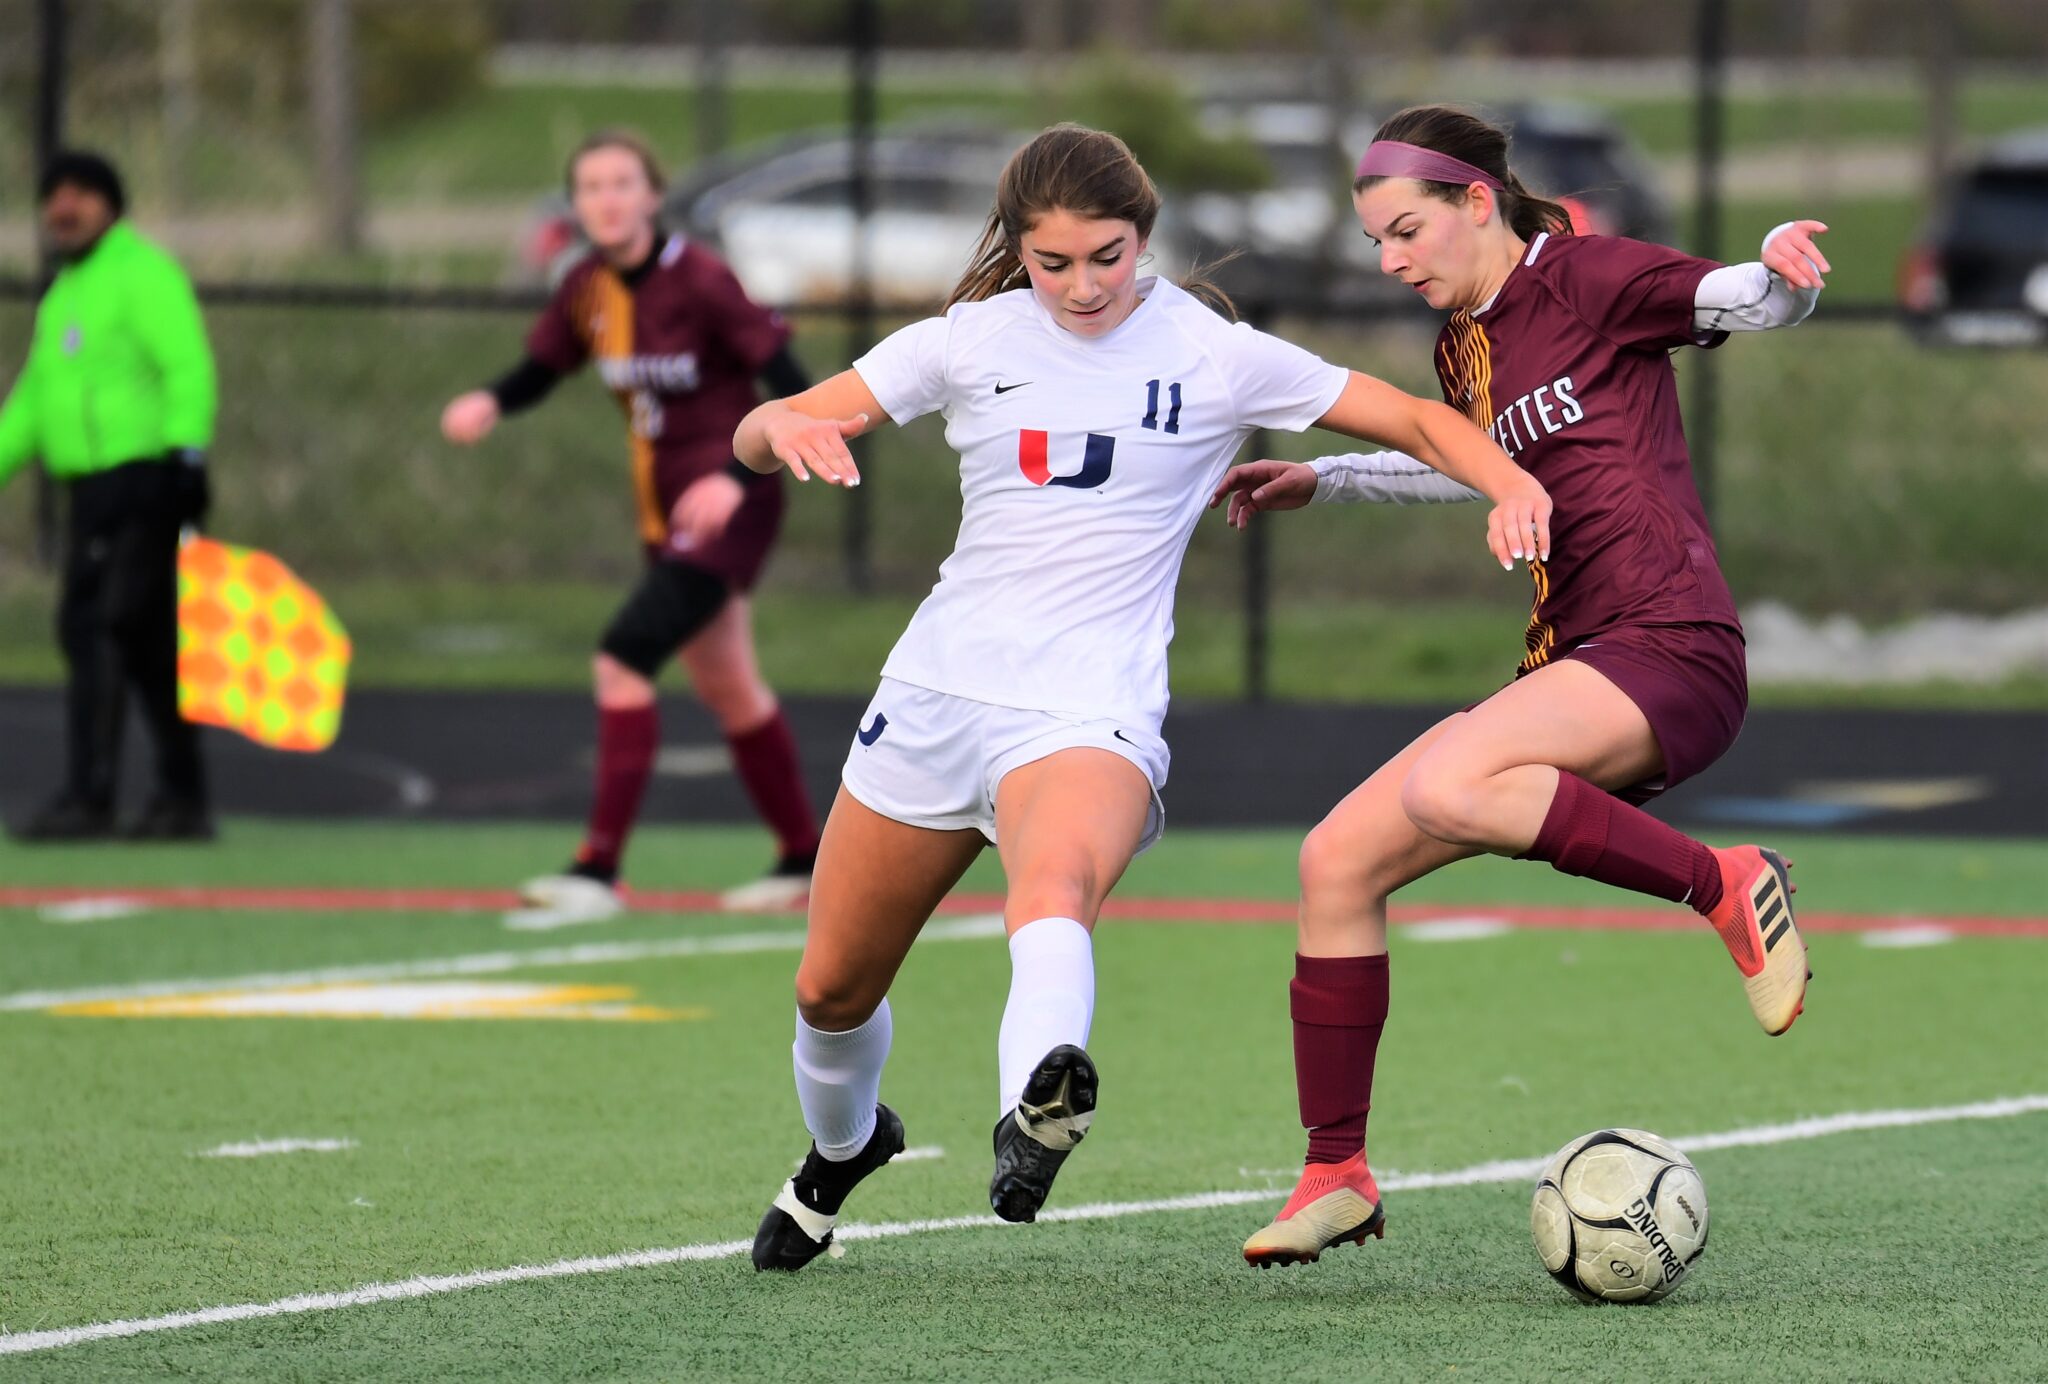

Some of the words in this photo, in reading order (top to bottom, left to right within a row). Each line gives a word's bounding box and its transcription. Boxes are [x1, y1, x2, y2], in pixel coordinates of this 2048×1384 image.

[1141, 379, 1182, 434] 11
[1018, 428, 1116, 489] U
[1623, 1197, 1685, 1283] SPALDING
